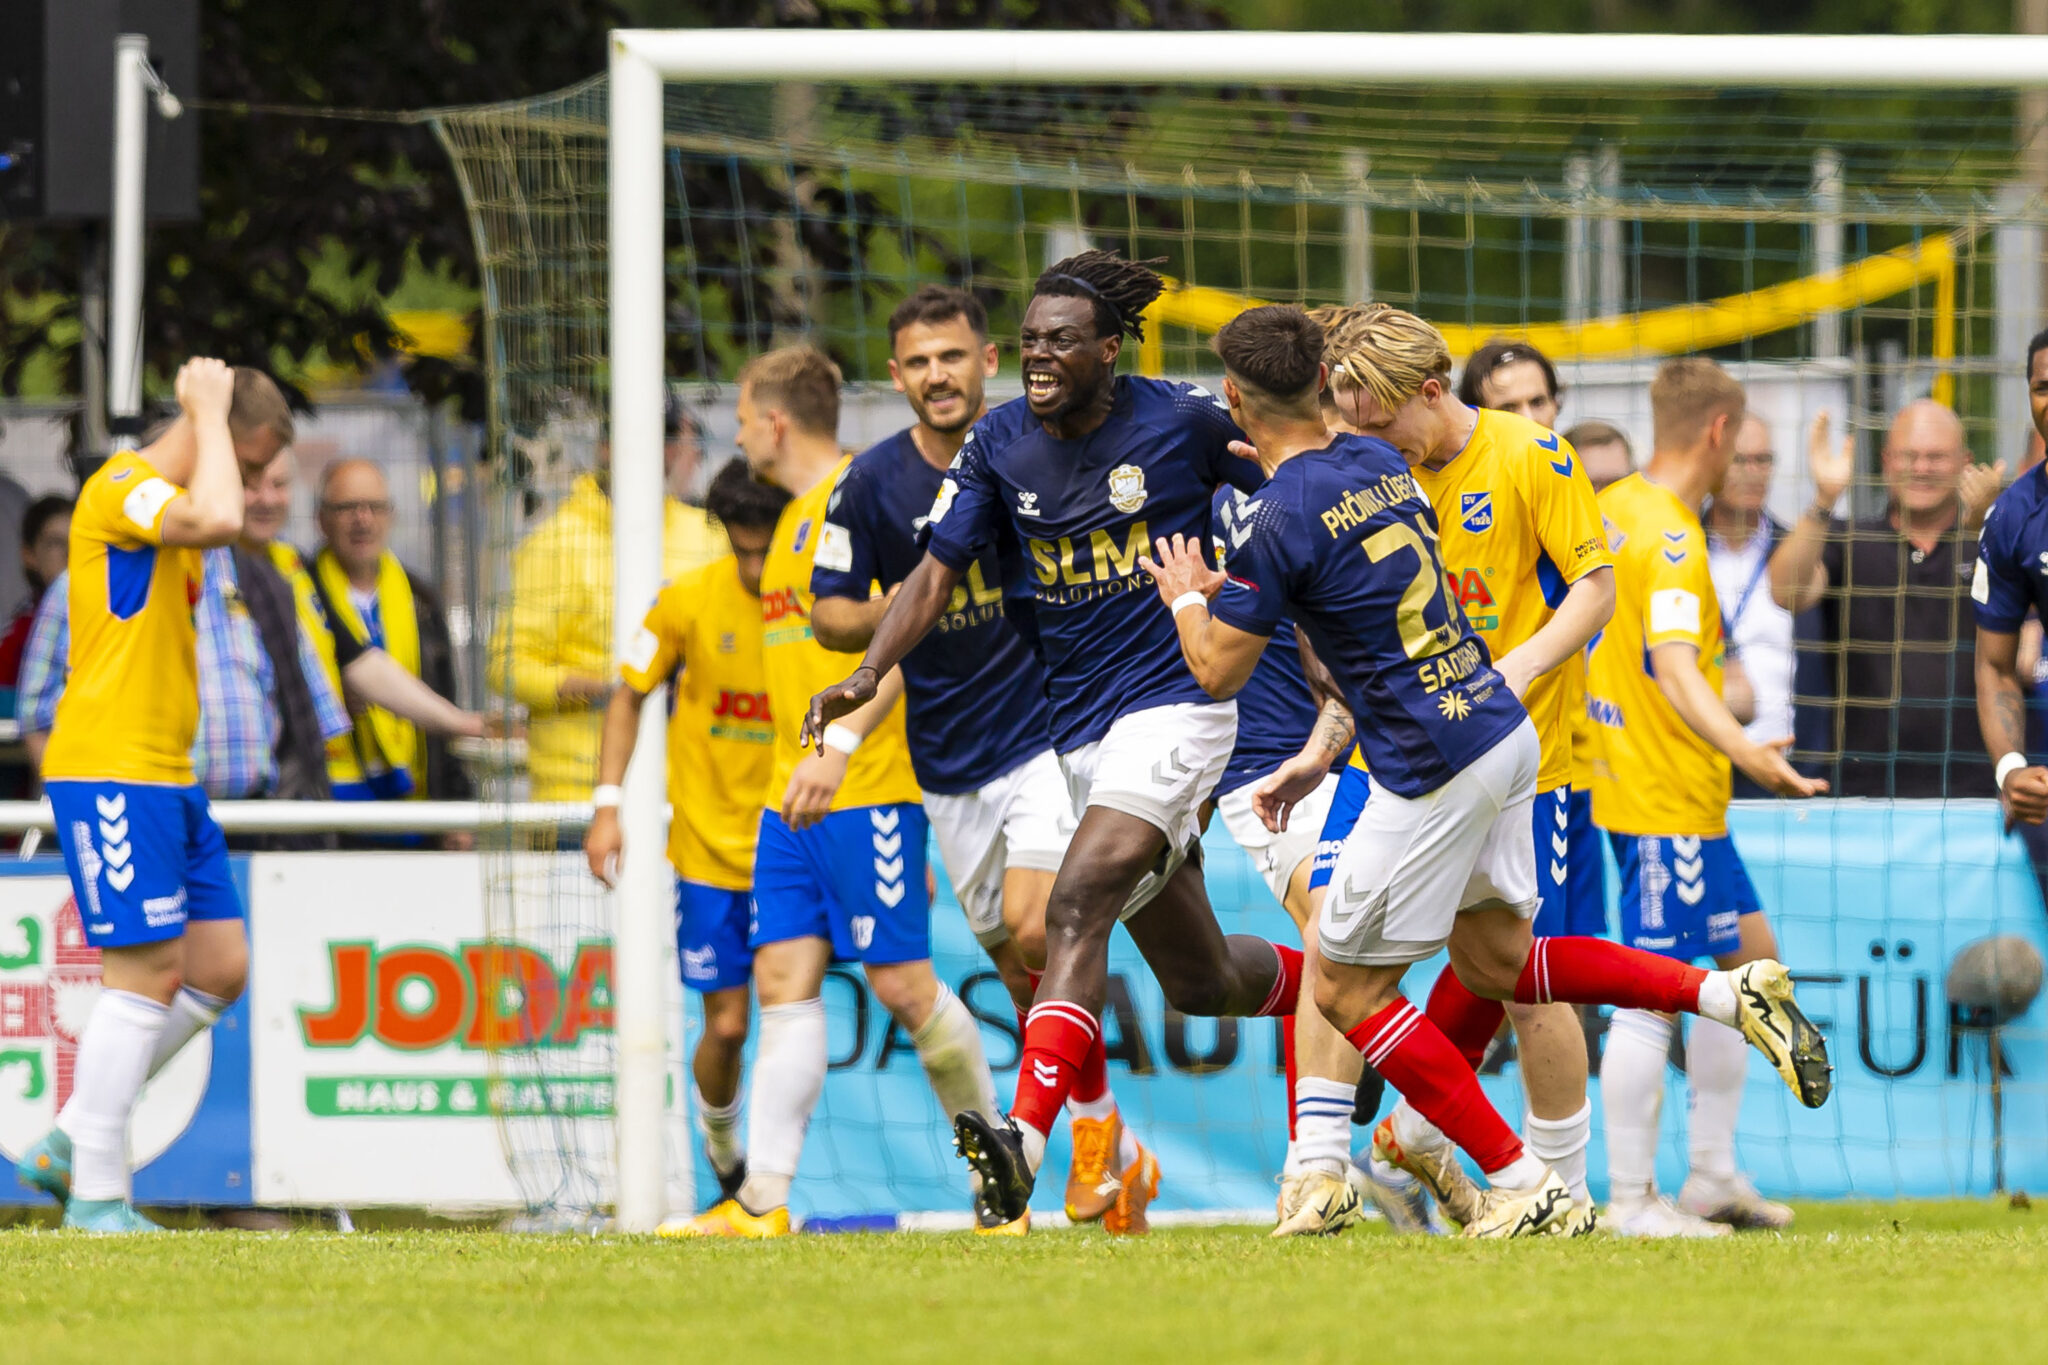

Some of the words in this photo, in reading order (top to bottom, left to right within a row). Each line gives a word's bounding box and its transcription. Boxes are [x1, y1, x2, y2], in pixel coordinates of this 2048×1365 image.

[1373, 472, 1418, 507] LÜBEC
[1029, 521, 1152, 586] SLM
[1035, 572, 1155, 605] SOLUTIONS
[336, 1080, 439, 1113] HAUS
[449, 1080, 478, 1112] &
